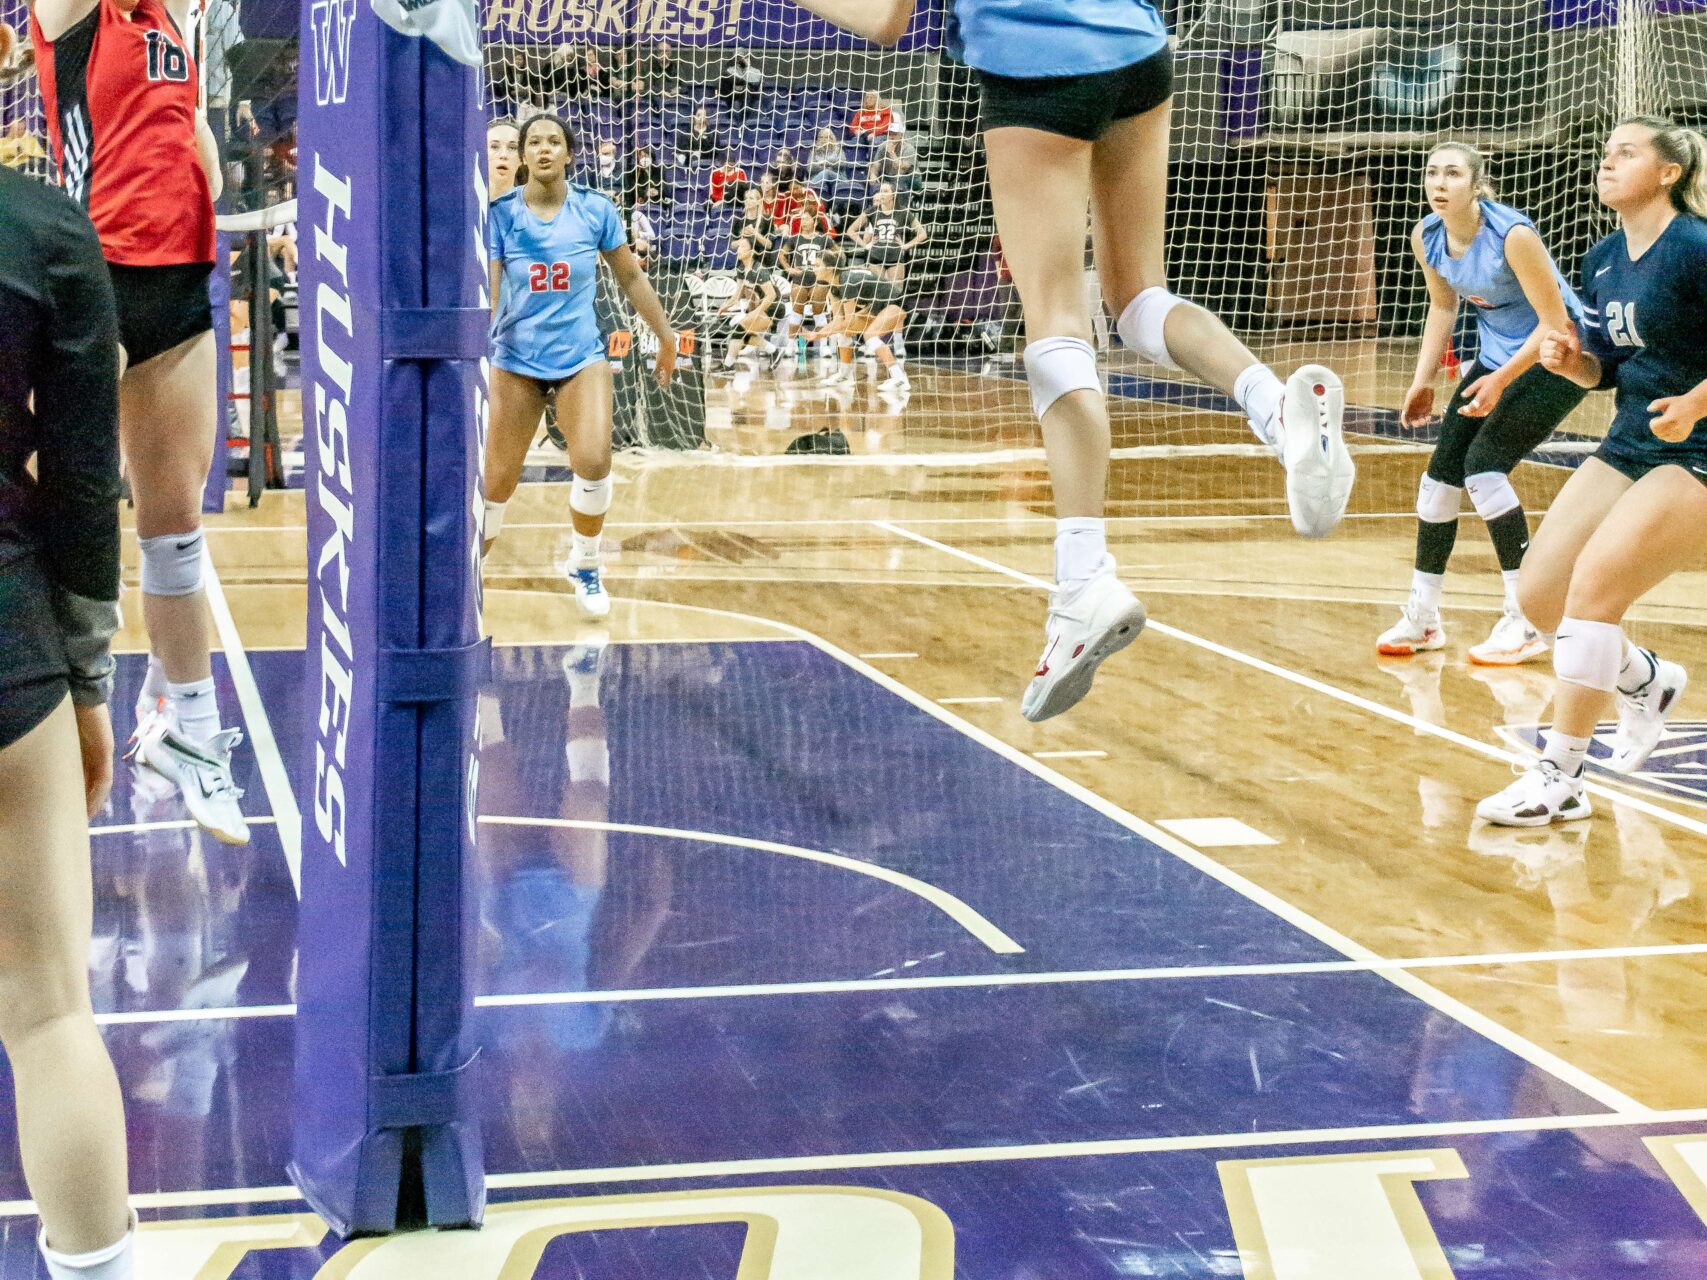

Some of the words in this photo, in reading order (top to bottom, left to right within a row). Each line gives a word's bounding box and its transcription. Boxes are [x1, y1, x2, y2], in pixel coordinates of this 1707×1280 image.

[879, 224, 896, 240] 22
[528, 261, 571, 294] 22
[1606, 301, 1645, 347] 21
[313, 153, 353, 868] HUSKIES
